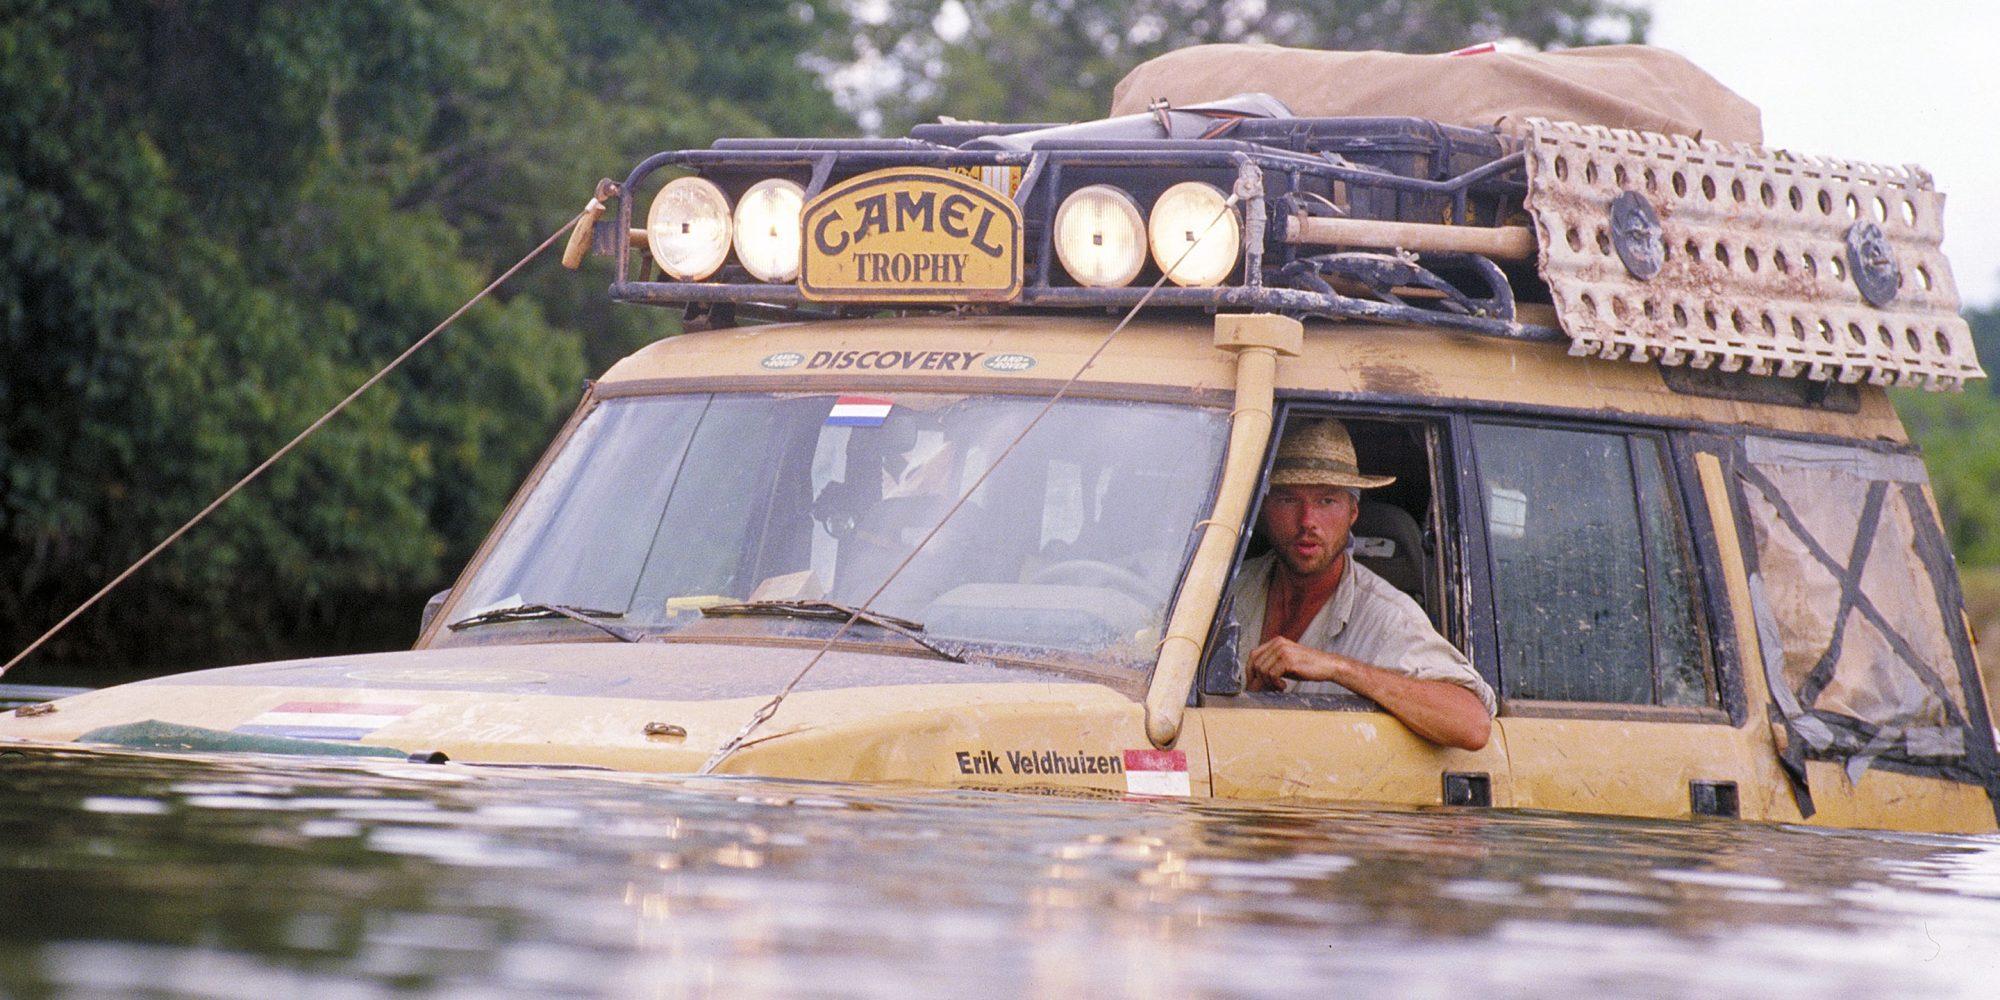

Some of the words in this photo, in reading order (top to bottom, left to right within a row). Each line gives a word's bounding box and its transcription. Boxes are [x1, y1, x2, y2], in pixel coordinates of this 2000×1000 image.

[815, 191, 1003, 258] CAMEL
[853, 252, 969, 282] TROPHY
[806, 351, 985, 370] DISCOVERY
[956, 750, 1003, 774] Erik
[1006, 749, 1123, 774] Veldhuizen
